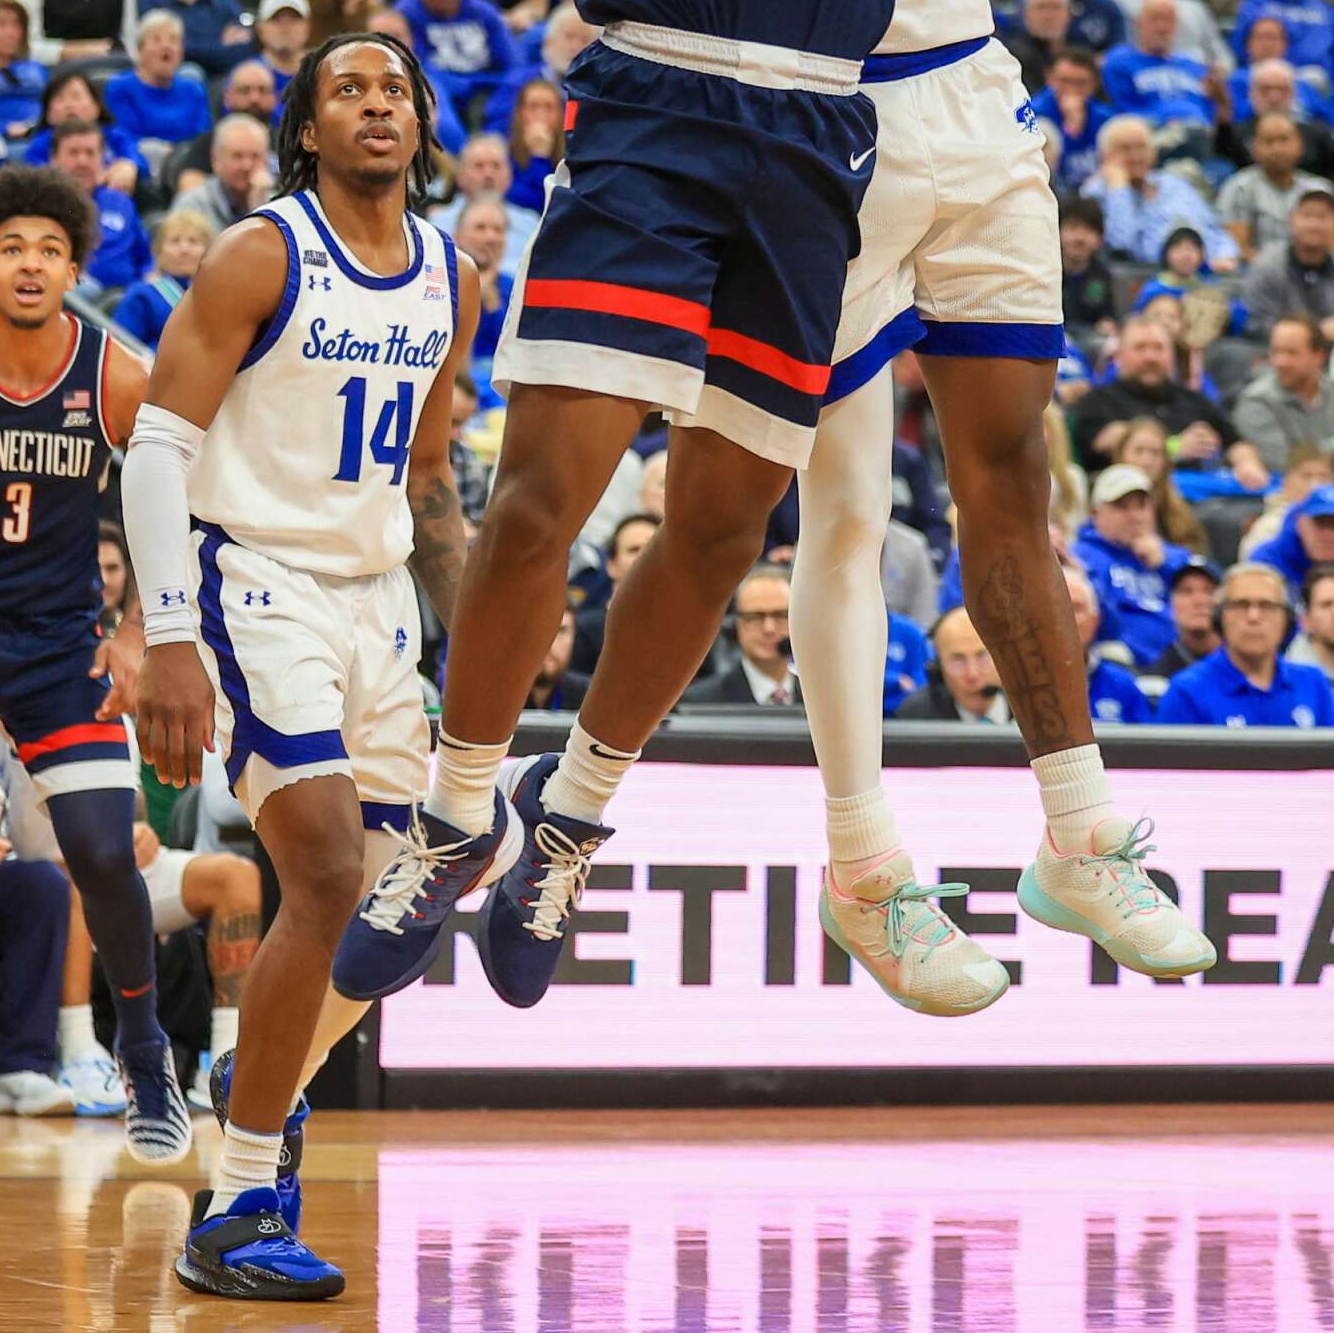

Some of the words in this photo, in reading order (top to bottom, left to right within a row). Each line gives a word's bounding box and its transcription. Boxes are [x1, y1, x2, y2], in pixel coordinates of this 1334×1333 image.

[302, 317, 380, 364] Seton
[383, 323, 448, 370] Hall
[332, 375, 415, 487] 14
[1, 481, 32, 544] 3
